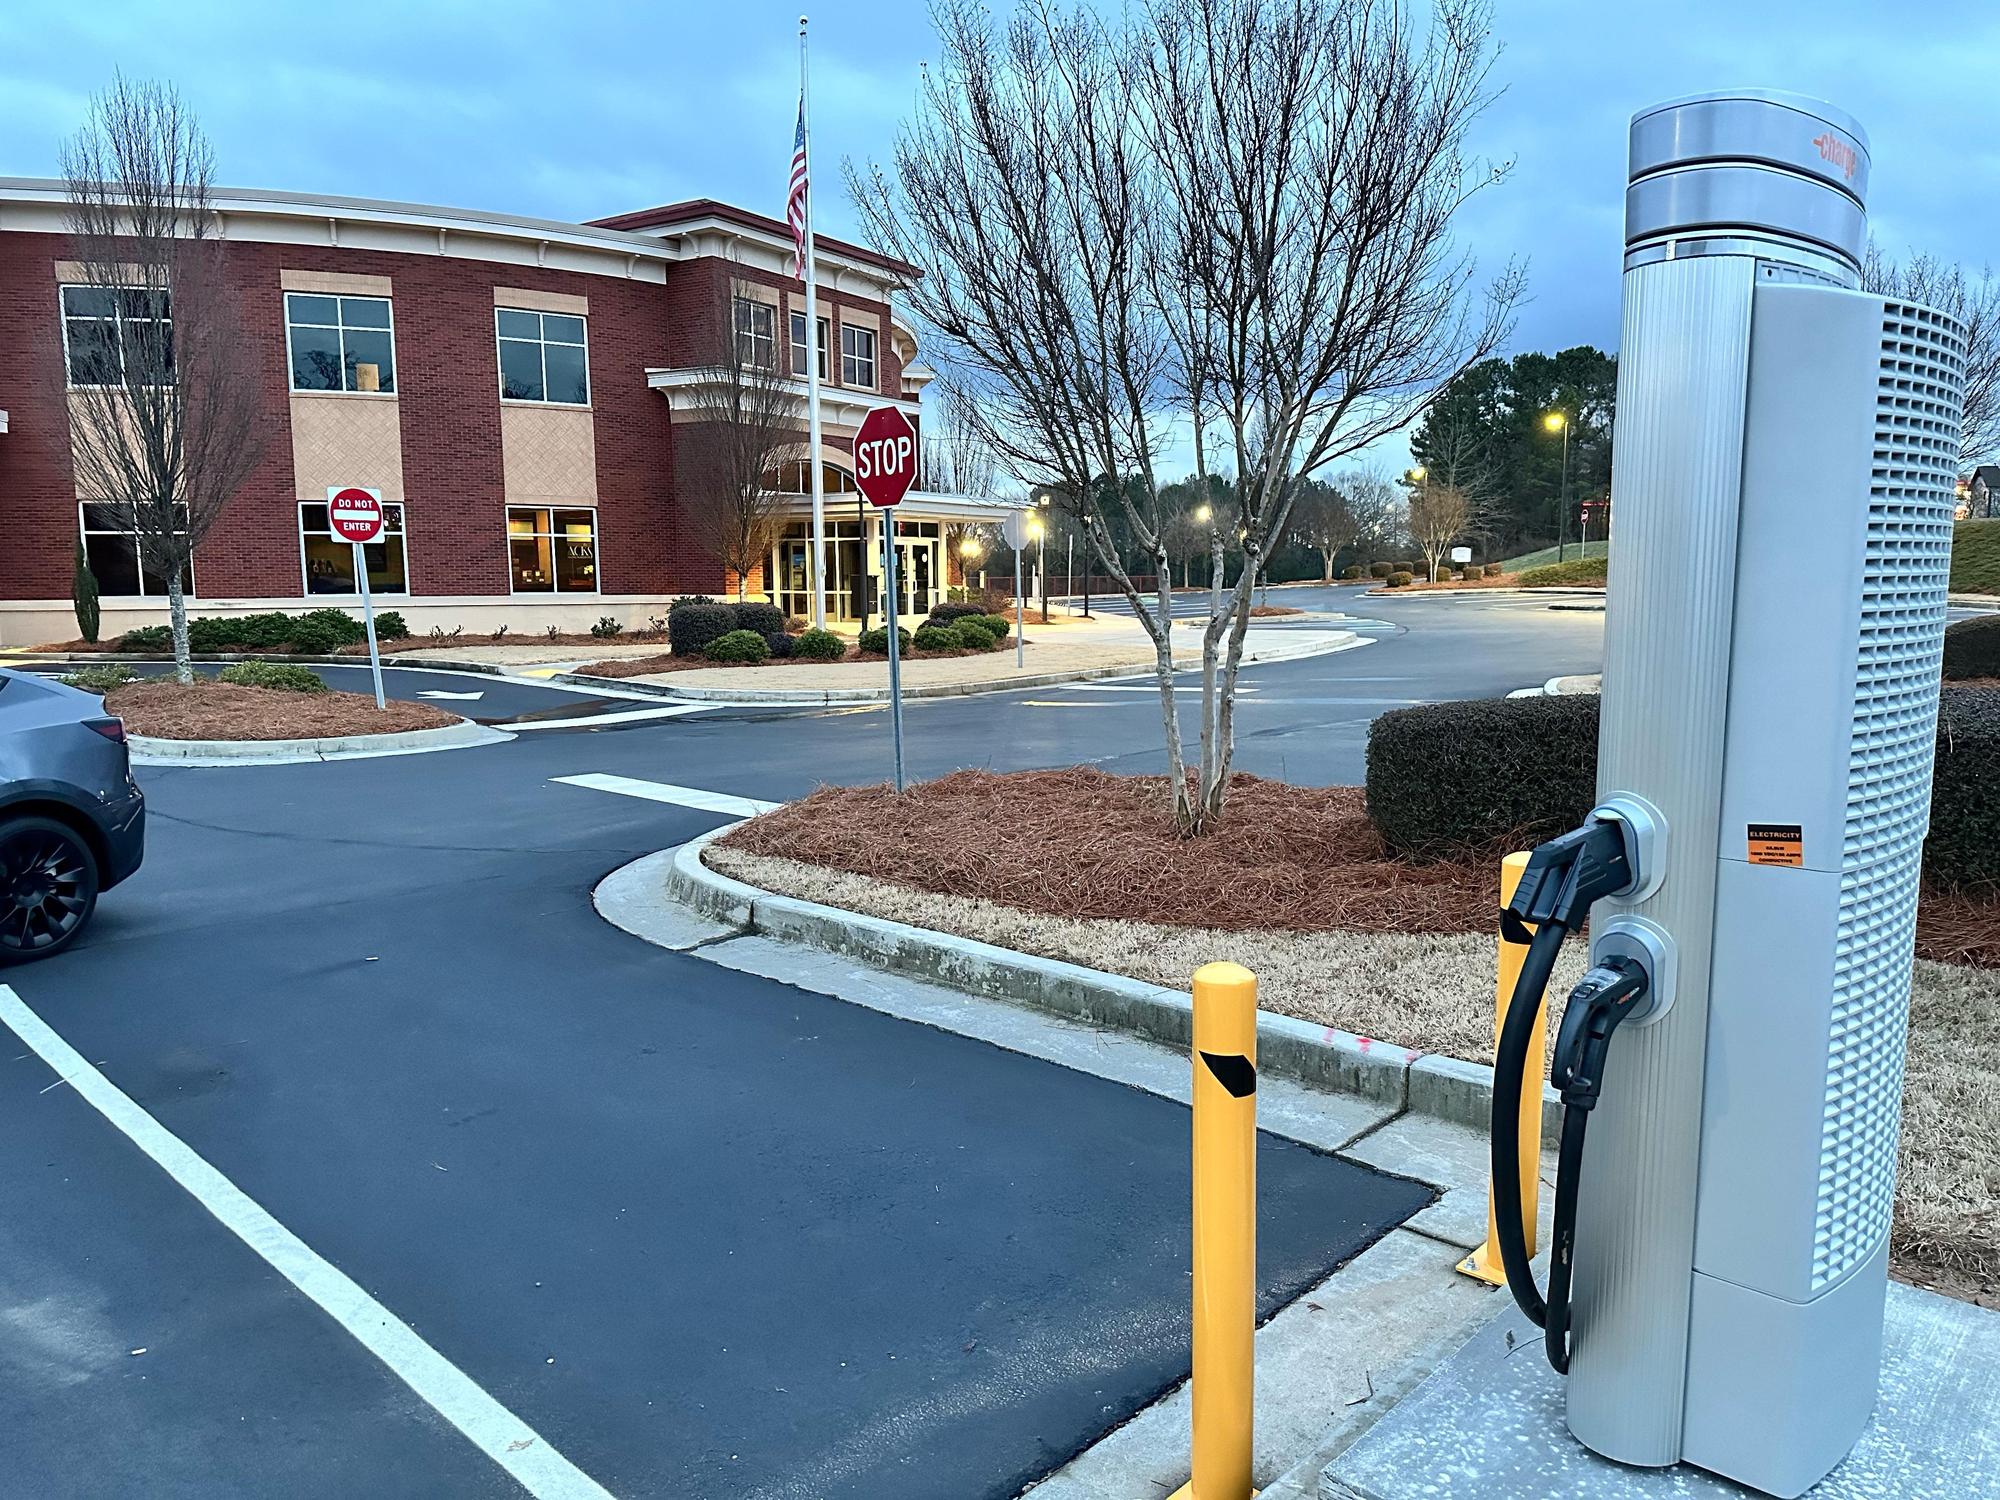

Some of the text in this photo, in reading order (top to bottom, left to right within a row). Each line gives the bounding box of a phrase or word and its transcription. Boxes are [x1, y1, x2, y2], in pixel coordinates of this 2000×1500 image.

[858, 436, 912, 479] STOP
[338, 498, 373, 509] DO NOT
[343, 521, 371, 532] ENTER
